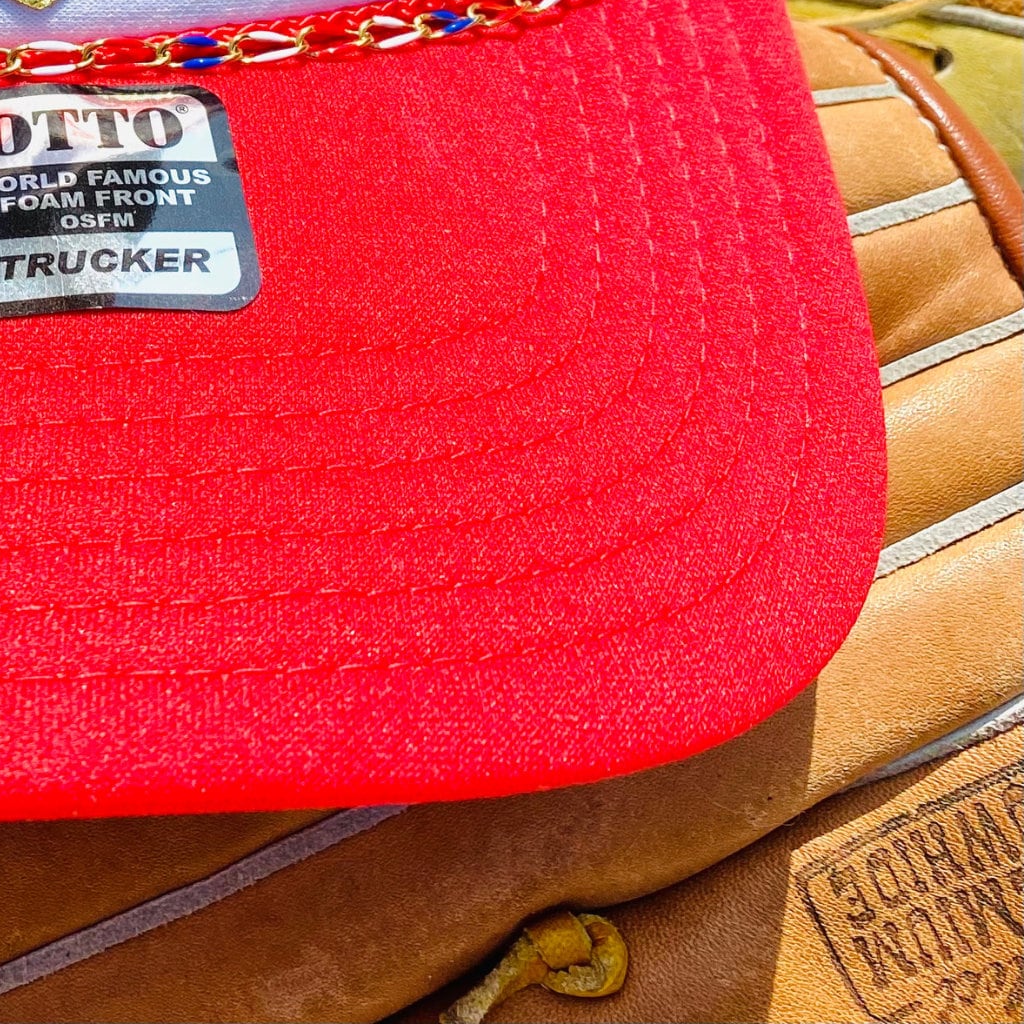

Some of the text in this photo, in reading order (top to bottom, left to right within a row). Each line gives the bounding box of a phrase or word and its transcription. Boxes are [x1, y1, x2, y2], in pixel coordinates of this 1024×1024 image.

[87, 167, 212, 187] FAMOUS
[0, 189, 197, 213] FOAM FRONT
[60, 212, 136, 230] OSFM
[851, 869, 1024, 991] MIUM
